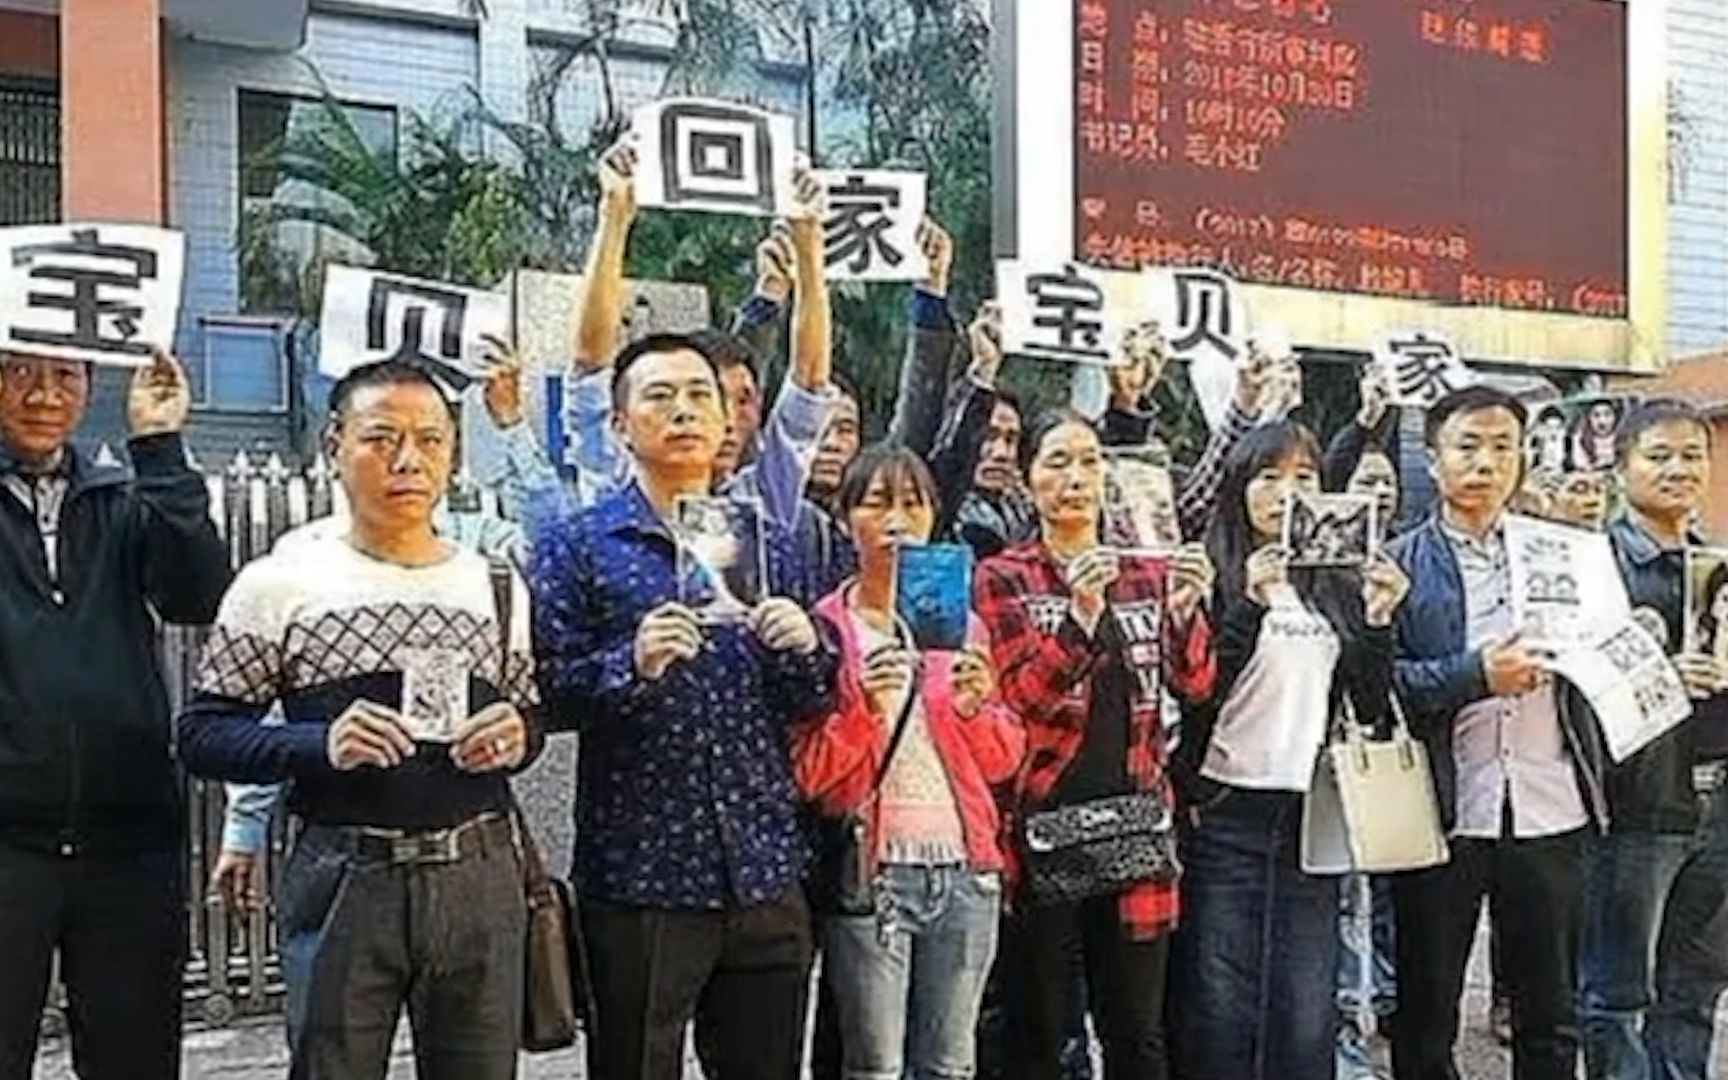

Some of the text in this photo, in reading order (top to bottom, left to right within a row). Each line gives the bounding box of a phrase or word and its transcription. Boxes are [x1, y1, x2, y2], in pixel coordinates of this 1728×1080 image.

[661, 103, 775, 212] 回
[823, 175, 903, 273] 家
[8, 228, 158, 356] 宝
[367, 277, 473, 392] 贝
[1022, 264, 1111, 358] 宝
[1168, 273, 1239, 358] 贝
[1388, 334, 1456, 400] 家
